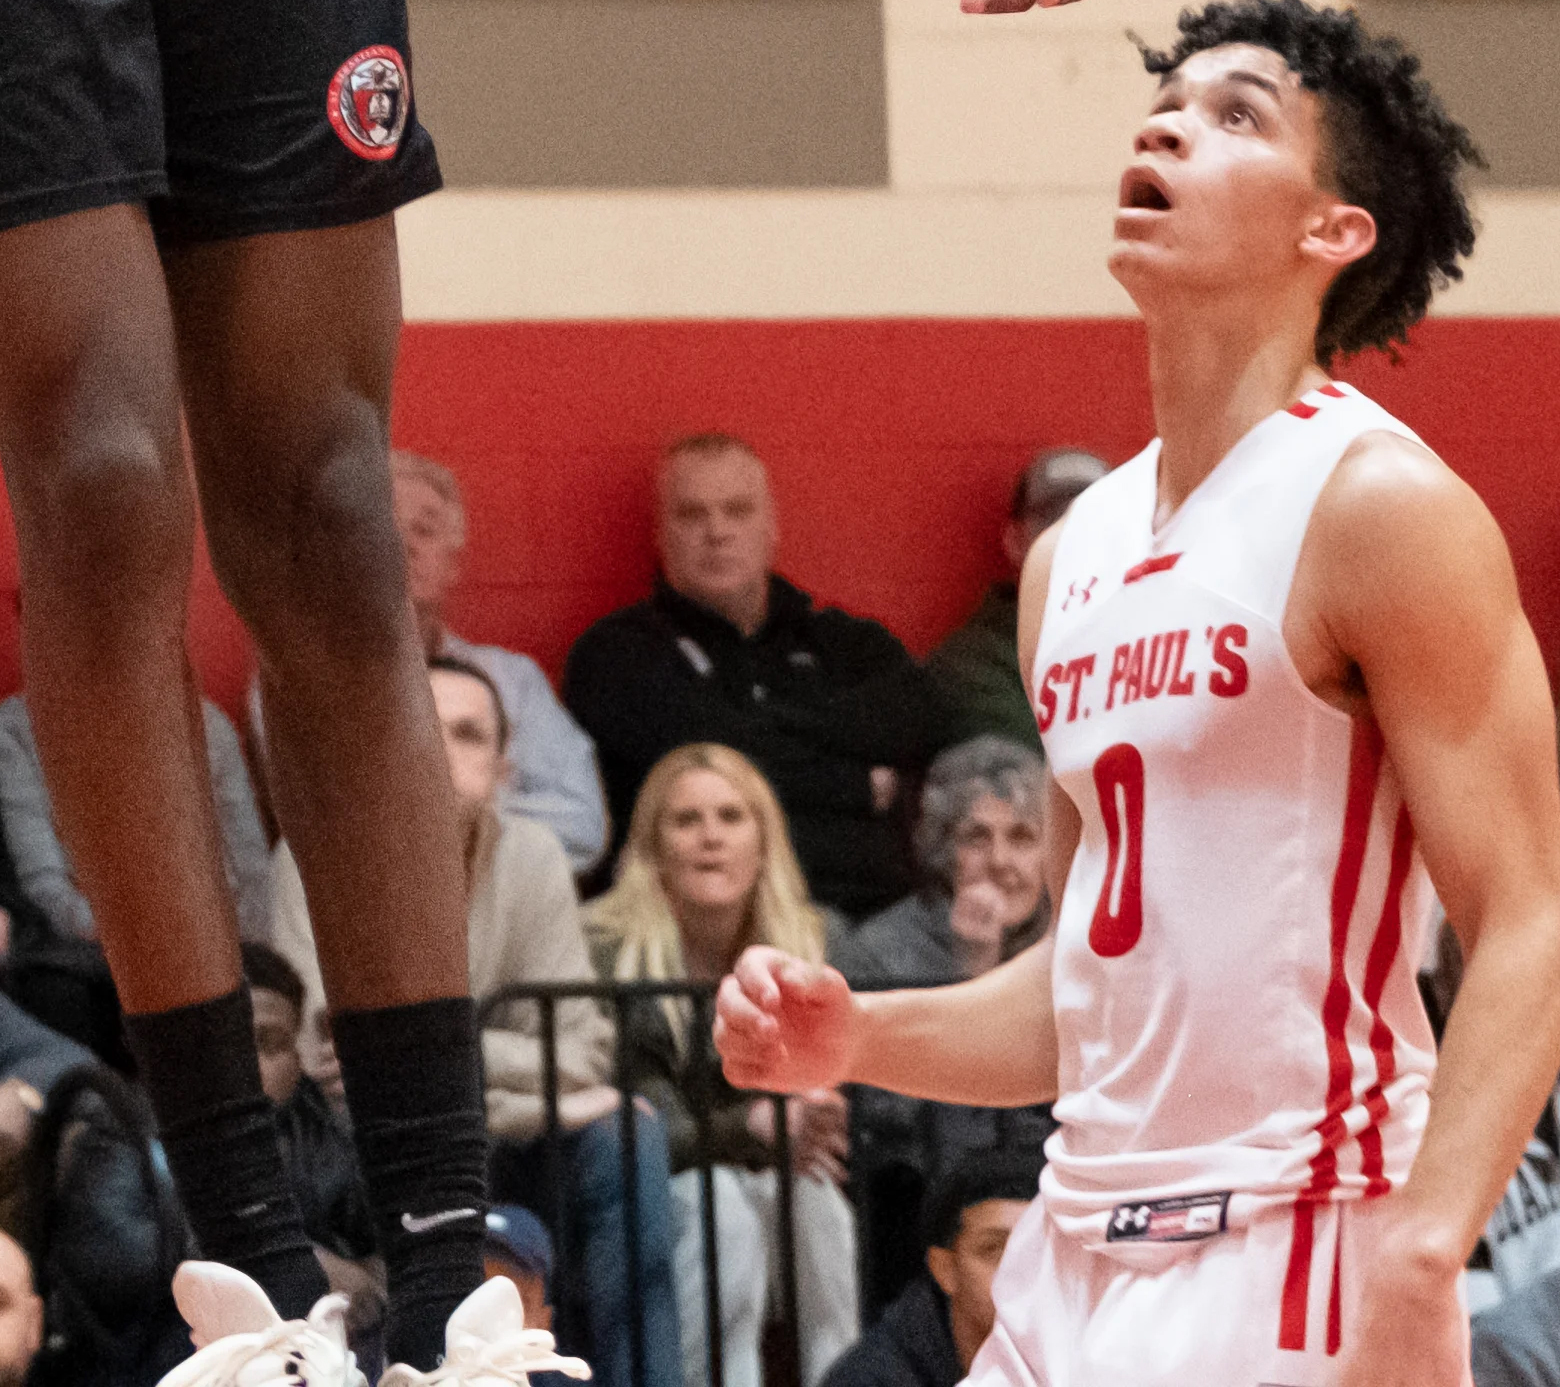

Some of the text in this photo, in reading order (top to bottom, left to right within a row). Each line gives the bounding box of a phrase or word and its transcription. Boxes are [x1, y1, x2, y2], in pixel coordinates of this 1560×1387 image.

[1037, 623, 1250, 735] ST. PAUL'S
[1088, 742, 1145, 958] 0
